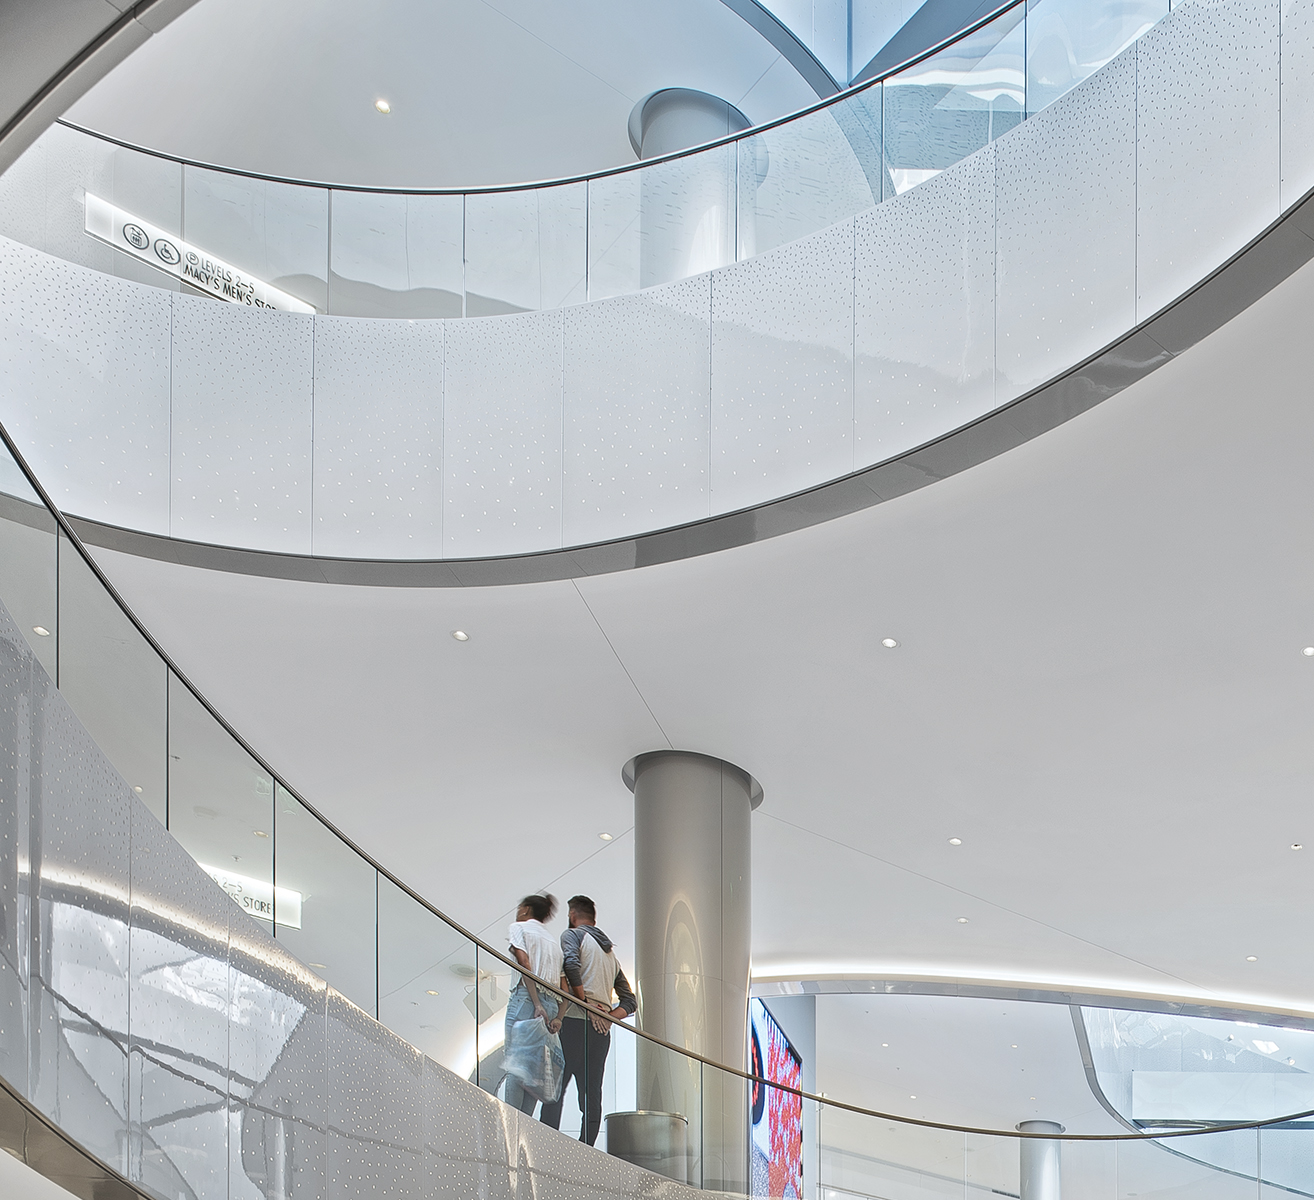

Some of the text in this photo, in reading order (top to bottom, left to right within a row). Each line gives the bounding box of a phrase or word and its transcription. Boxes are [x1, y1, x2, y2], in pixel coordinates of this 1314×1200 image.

[202, 258, 232, 283] LEVELS
[184, 265, 220, 290] MACY'S
[223, 283, 252, 306] MEN'S
[243, 897, 271, 914] STORE
